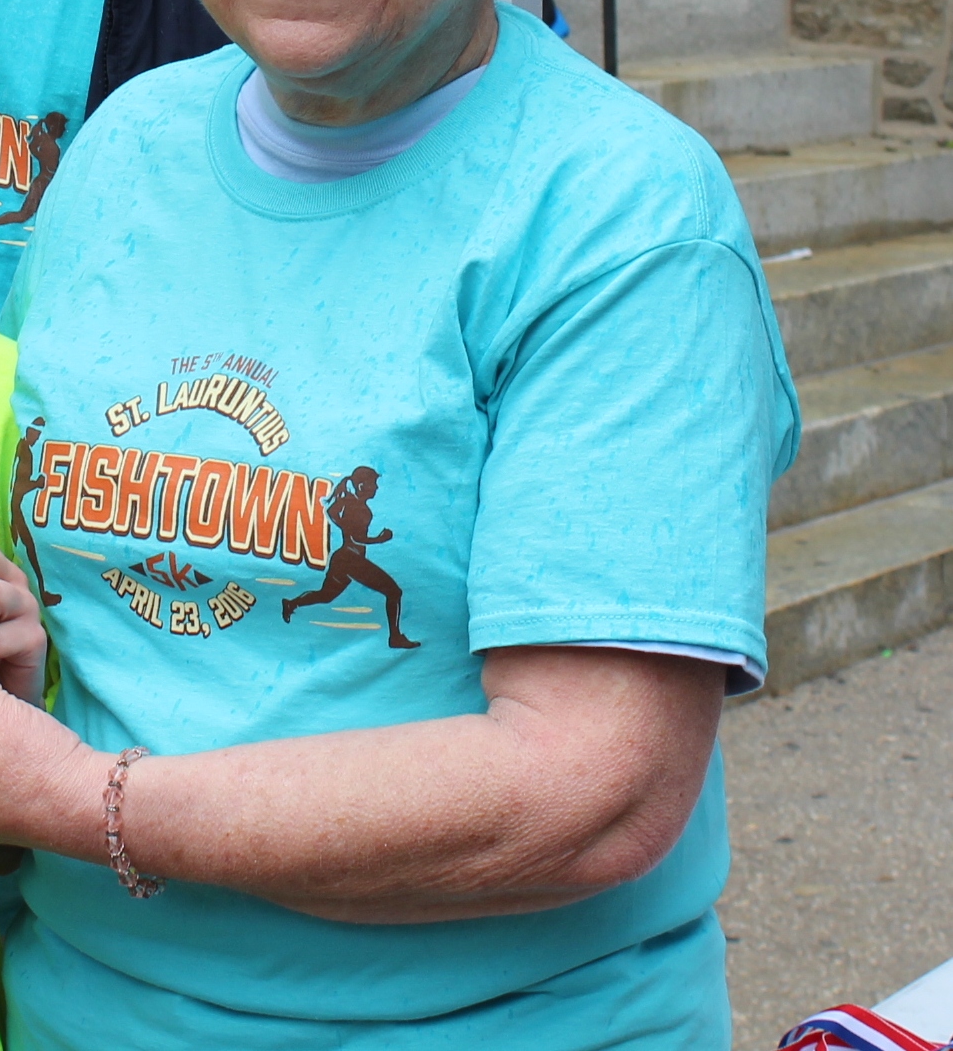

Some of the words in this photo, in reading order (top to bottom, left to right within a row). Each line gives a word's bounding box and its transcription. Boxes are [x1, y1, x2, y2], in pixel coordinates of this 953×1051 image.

[171, 355, 200, 375] THE
[201, 352, 223, 371] 5TH
[221, 353, 280, 389] ANNUAL
[105, 395, 151, 437] ST.
[156, 373, 291, 457] LAURUNTIUS
[32, 439, 335, 570] FISHTOWN
[101, 567, 164, 629] APRIL
[170, 600, 212, 639] 23,
[207, 581, 257, 630] 2016
[145, 550, 200, 591] 5K
